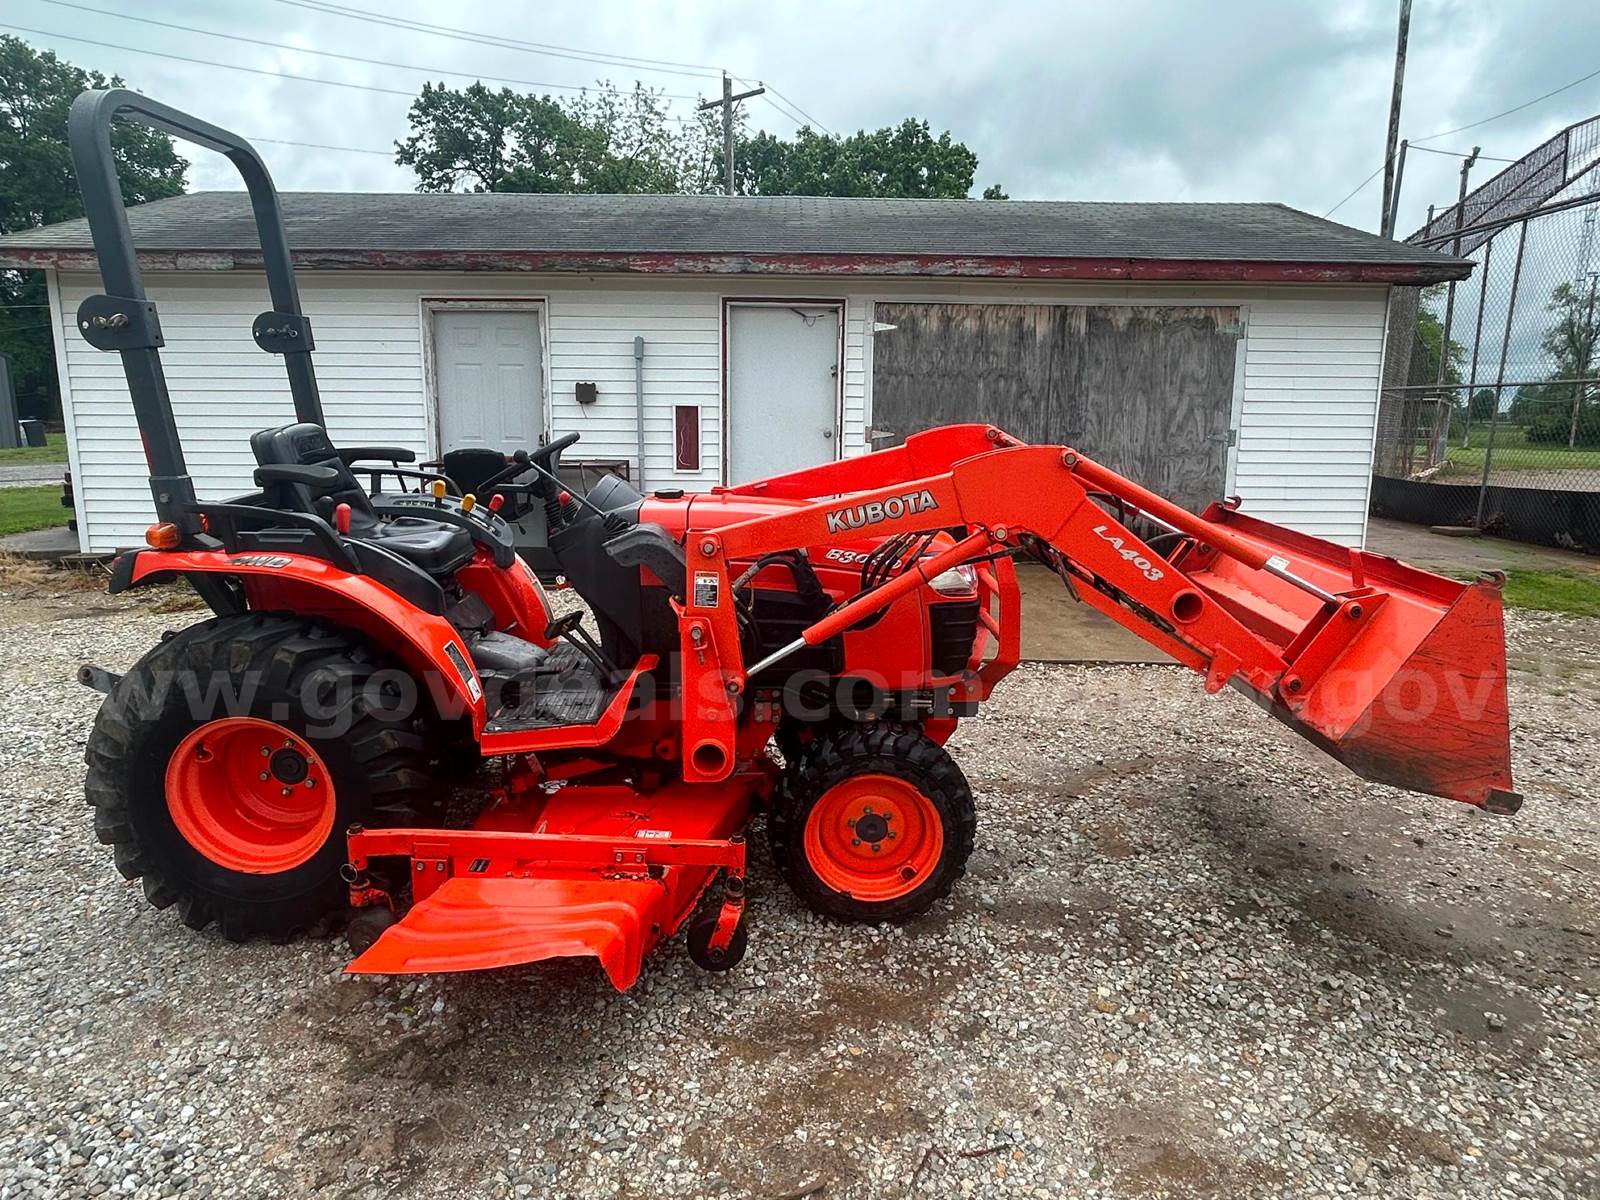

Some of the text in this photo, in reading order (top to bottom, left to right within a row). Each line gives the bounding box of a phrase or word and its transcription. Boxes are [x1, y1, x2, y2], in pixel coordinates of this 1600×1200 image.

[825, 491, 938, 533] KUBOTA
[825, 549, 902, 569] B300
[1092, 525, 1164, 581] LA403
